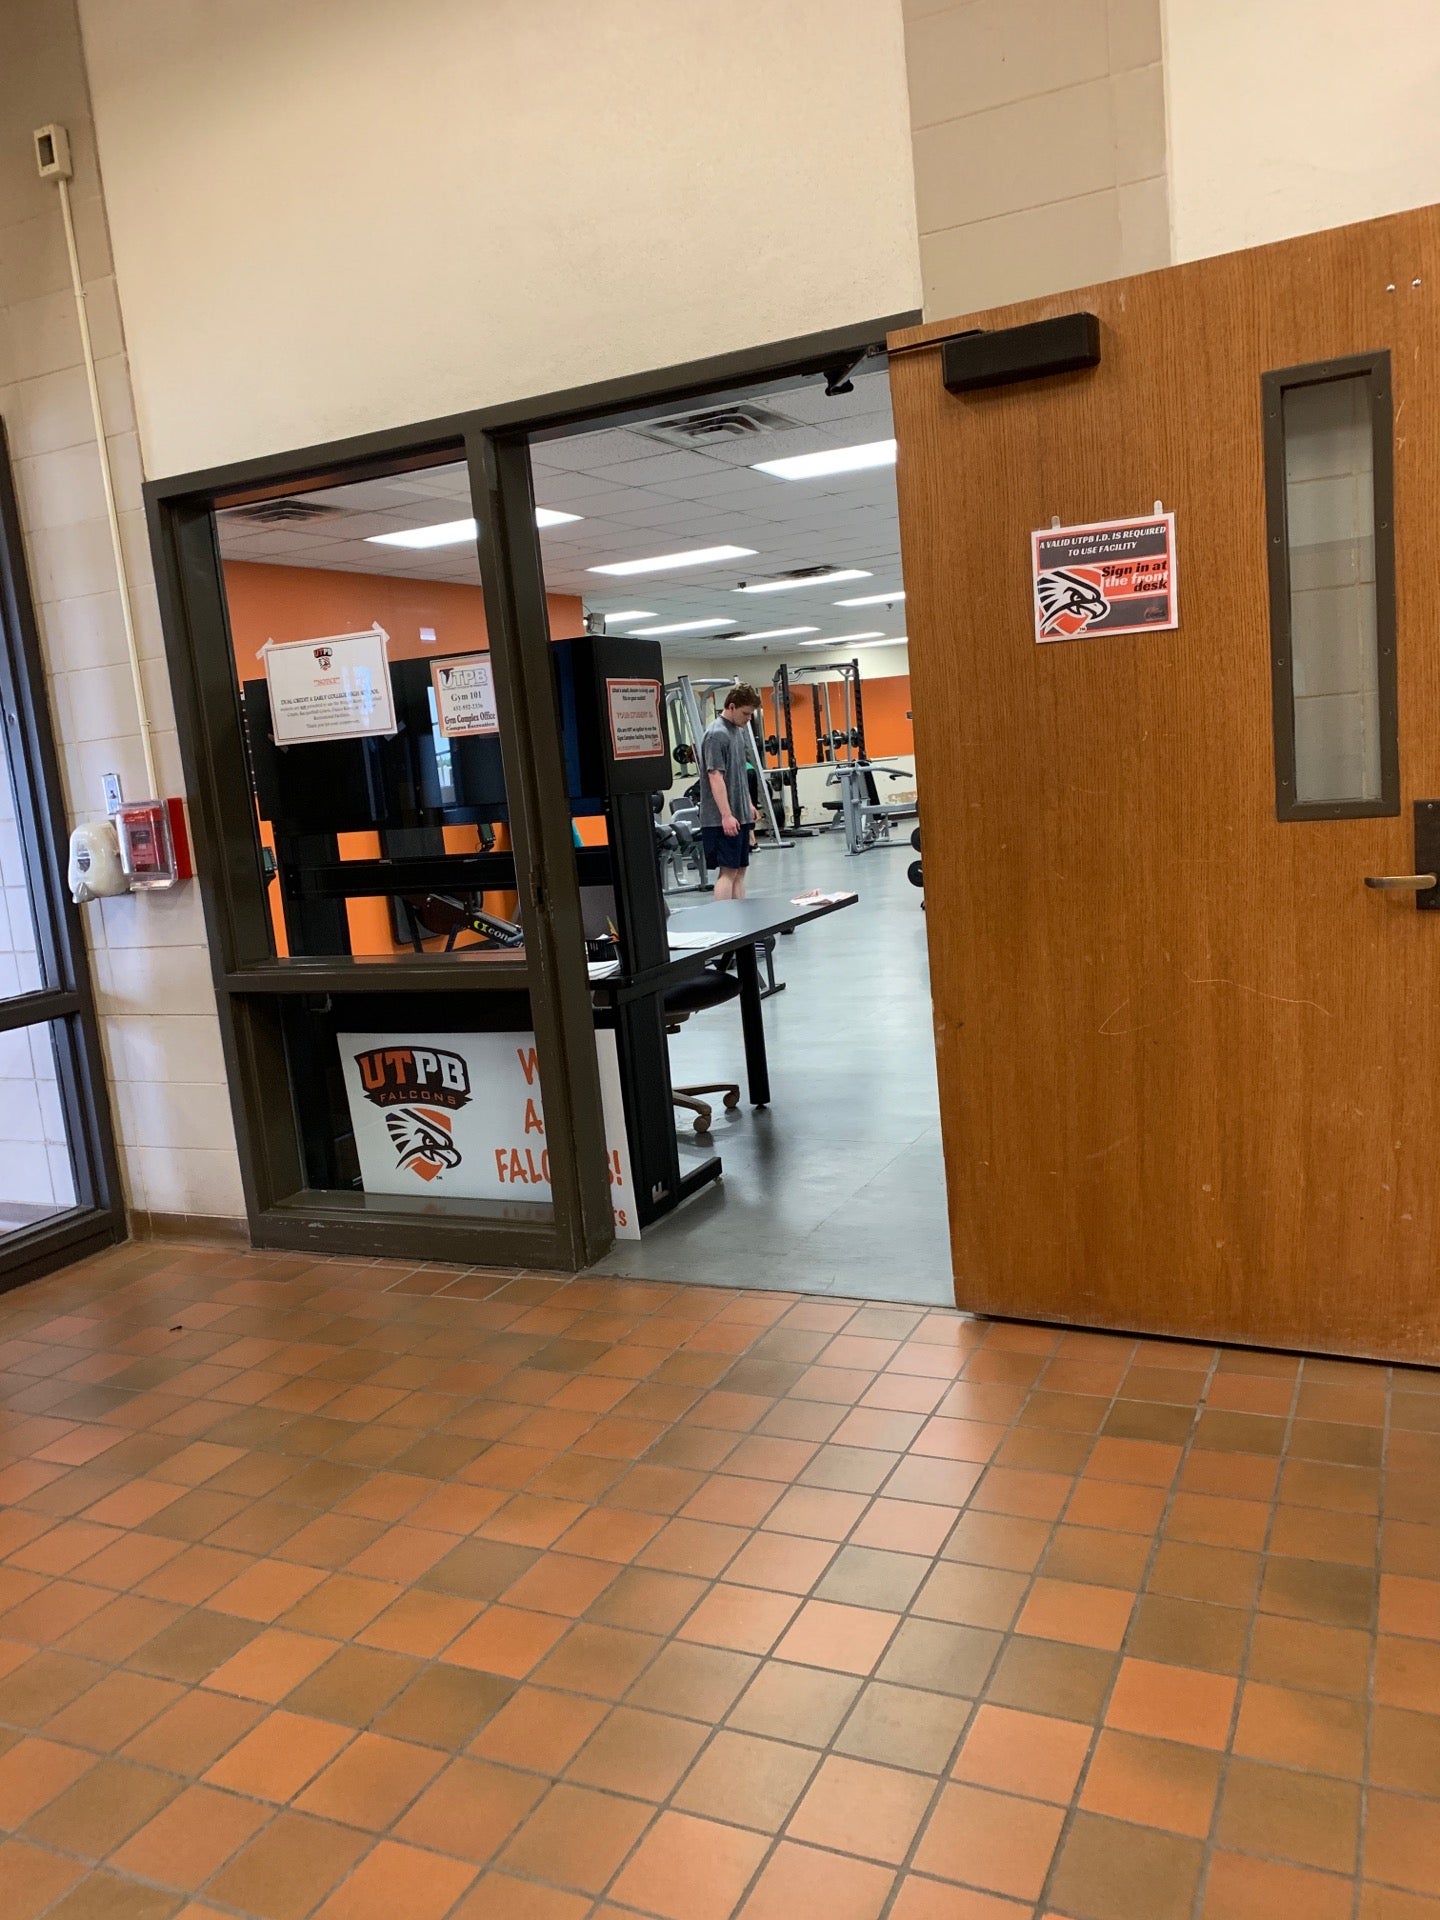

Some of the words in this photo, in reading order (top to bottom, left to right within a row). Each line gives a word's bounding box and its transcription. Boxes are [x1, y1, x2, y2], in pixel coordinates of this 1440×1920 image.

[1046, 538, 1070, 548] VALID
[1071, 535, 1095, 545] UTPB
[1095, 533, 1110, 542] I.D.
[1112, 532, 1121, 540] IS
[1122, 526, 1166, 539] REQUIRED
[1068, 549, 1080, 557] TO
[1081, 546, 1098, 555] USE
[1099, 541, 1137, 553] FACILITY
[1101, 565, 1133, 578] Sign
[1136, 562, 1150, 573] in
[1152, 560, 1167, 571] at
[1104, 576, 1129, 587] the
[1131, 571, 1169, 585] front
[1134, 578, 1168, 592] desk
[439, 667, 488, 687] UTPB
[451, 693, 469, 703] Gym
[470, 690, 482, 700] 101
[480, 711, 496, 720] Office
[360, 1050, 467, 1092] UTPB
[517, 1047, 540, 1085] W
[380, 1090, 456, 1105] FALCONS
